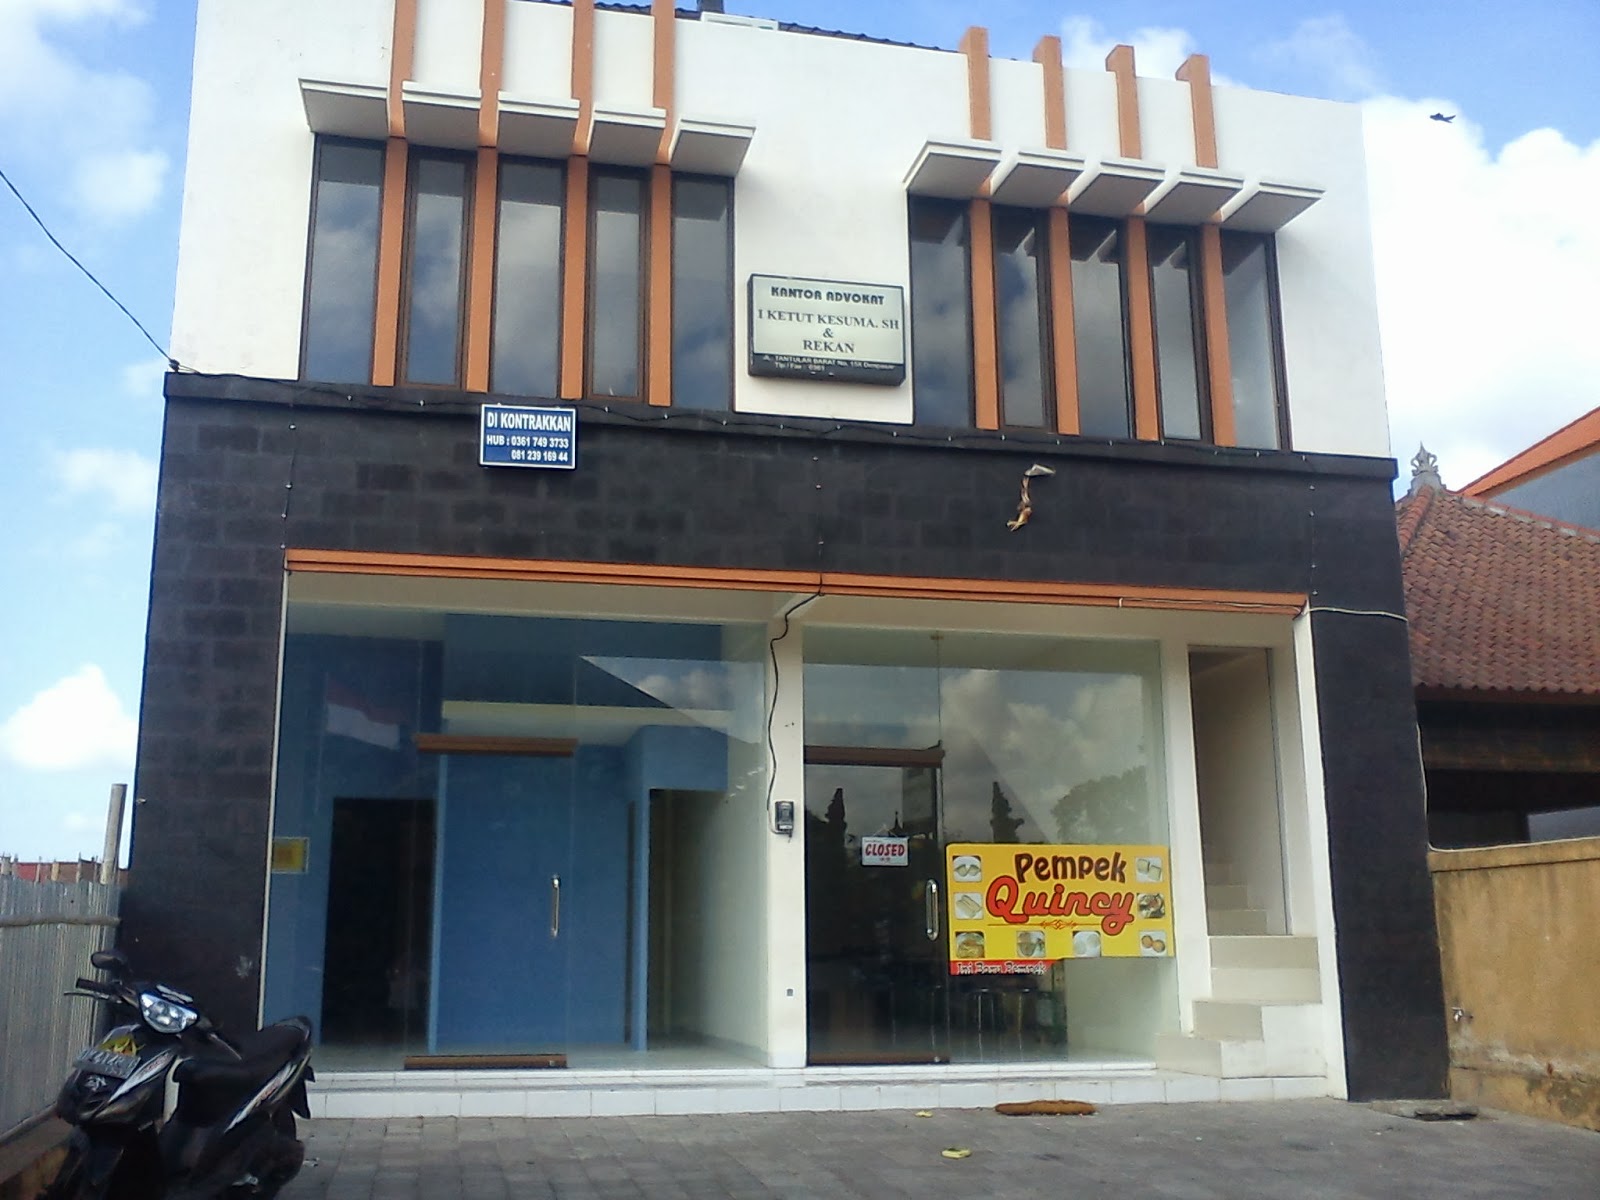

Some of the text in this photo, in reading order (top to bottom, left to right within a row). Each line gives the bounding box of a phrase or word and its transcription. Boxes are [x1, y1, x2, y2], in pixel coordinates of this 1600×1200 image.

[771, 286, 884, 305] KANTOR ADVOKAT
[758, 309, 763, 319] I
[767, 310, 814, 323] KETUT
[882, 319, 899, 329] SH
[822, 328, 834, 338] &
[803, 340, 855, 353] REKAN
[813, 358, 836, 366] BARAT
[487, 411, 571, 432] DI KONTRAKKAN
[486, 434, 505, 445] HUB
[511, 435, 531, 447] 0361
[532, 437, 548, 448] 749
[549, 437, 569, 449] 3733
[511, 449, 525, 460] 081
[527, 450, 541, 461] 239
[558, 451, 568, 462] 44
[865, 843, 905, 857] CLOSED
[1014, 852, 1127, 883] Pempek
[985, 875, 1135, 936] Quincy
